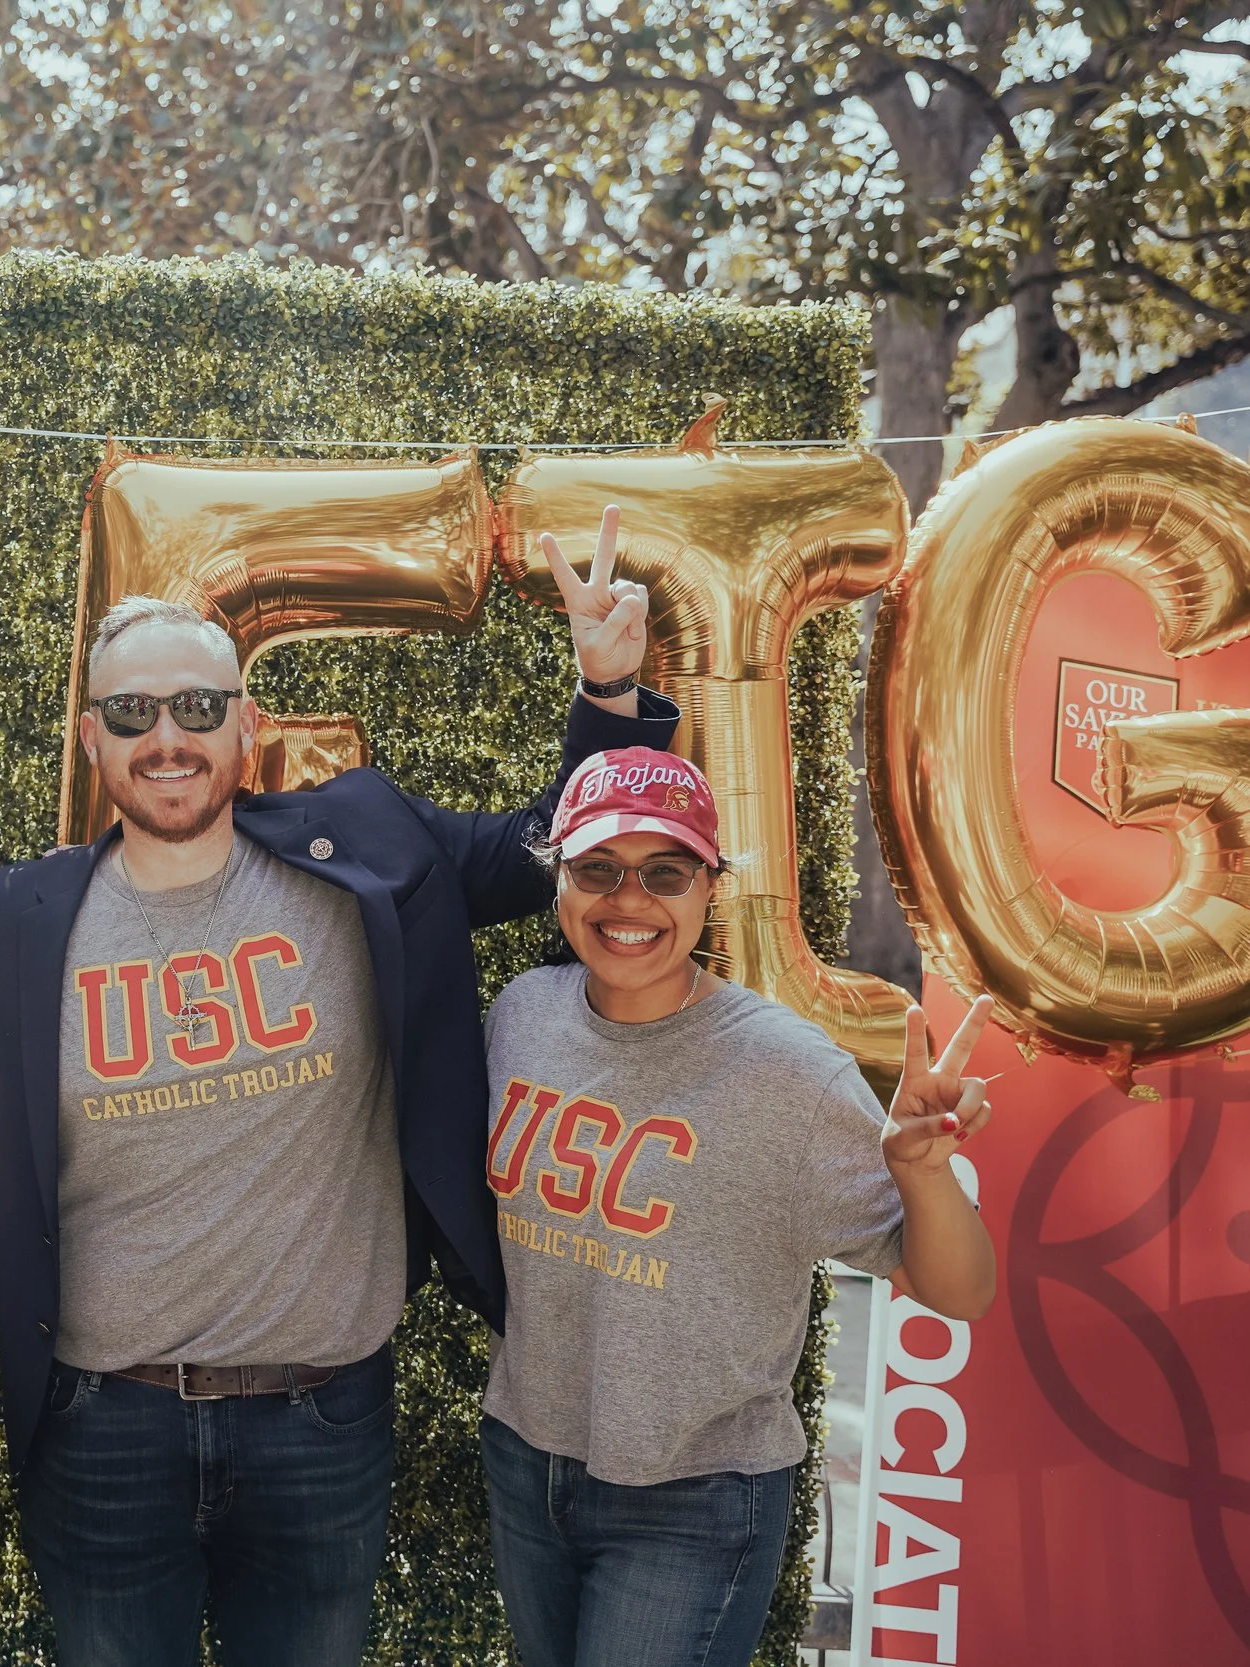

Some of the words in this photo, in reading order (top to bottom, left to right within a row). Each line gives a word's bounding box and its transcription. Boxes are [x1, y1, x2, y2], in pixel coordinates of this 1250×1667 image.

[1085, 679, 1148, 713] OUR
[582, 762, 696, 803] Trojans
[74, 930, 318, 1083] USC
[83, 1078, 218, 1121] CATHOLIC
[222, 1051, 335, 1100] TROJAN
[486, 1076, 698, 1240] USC
[572, 1233, 670, 1290] TROJAN
